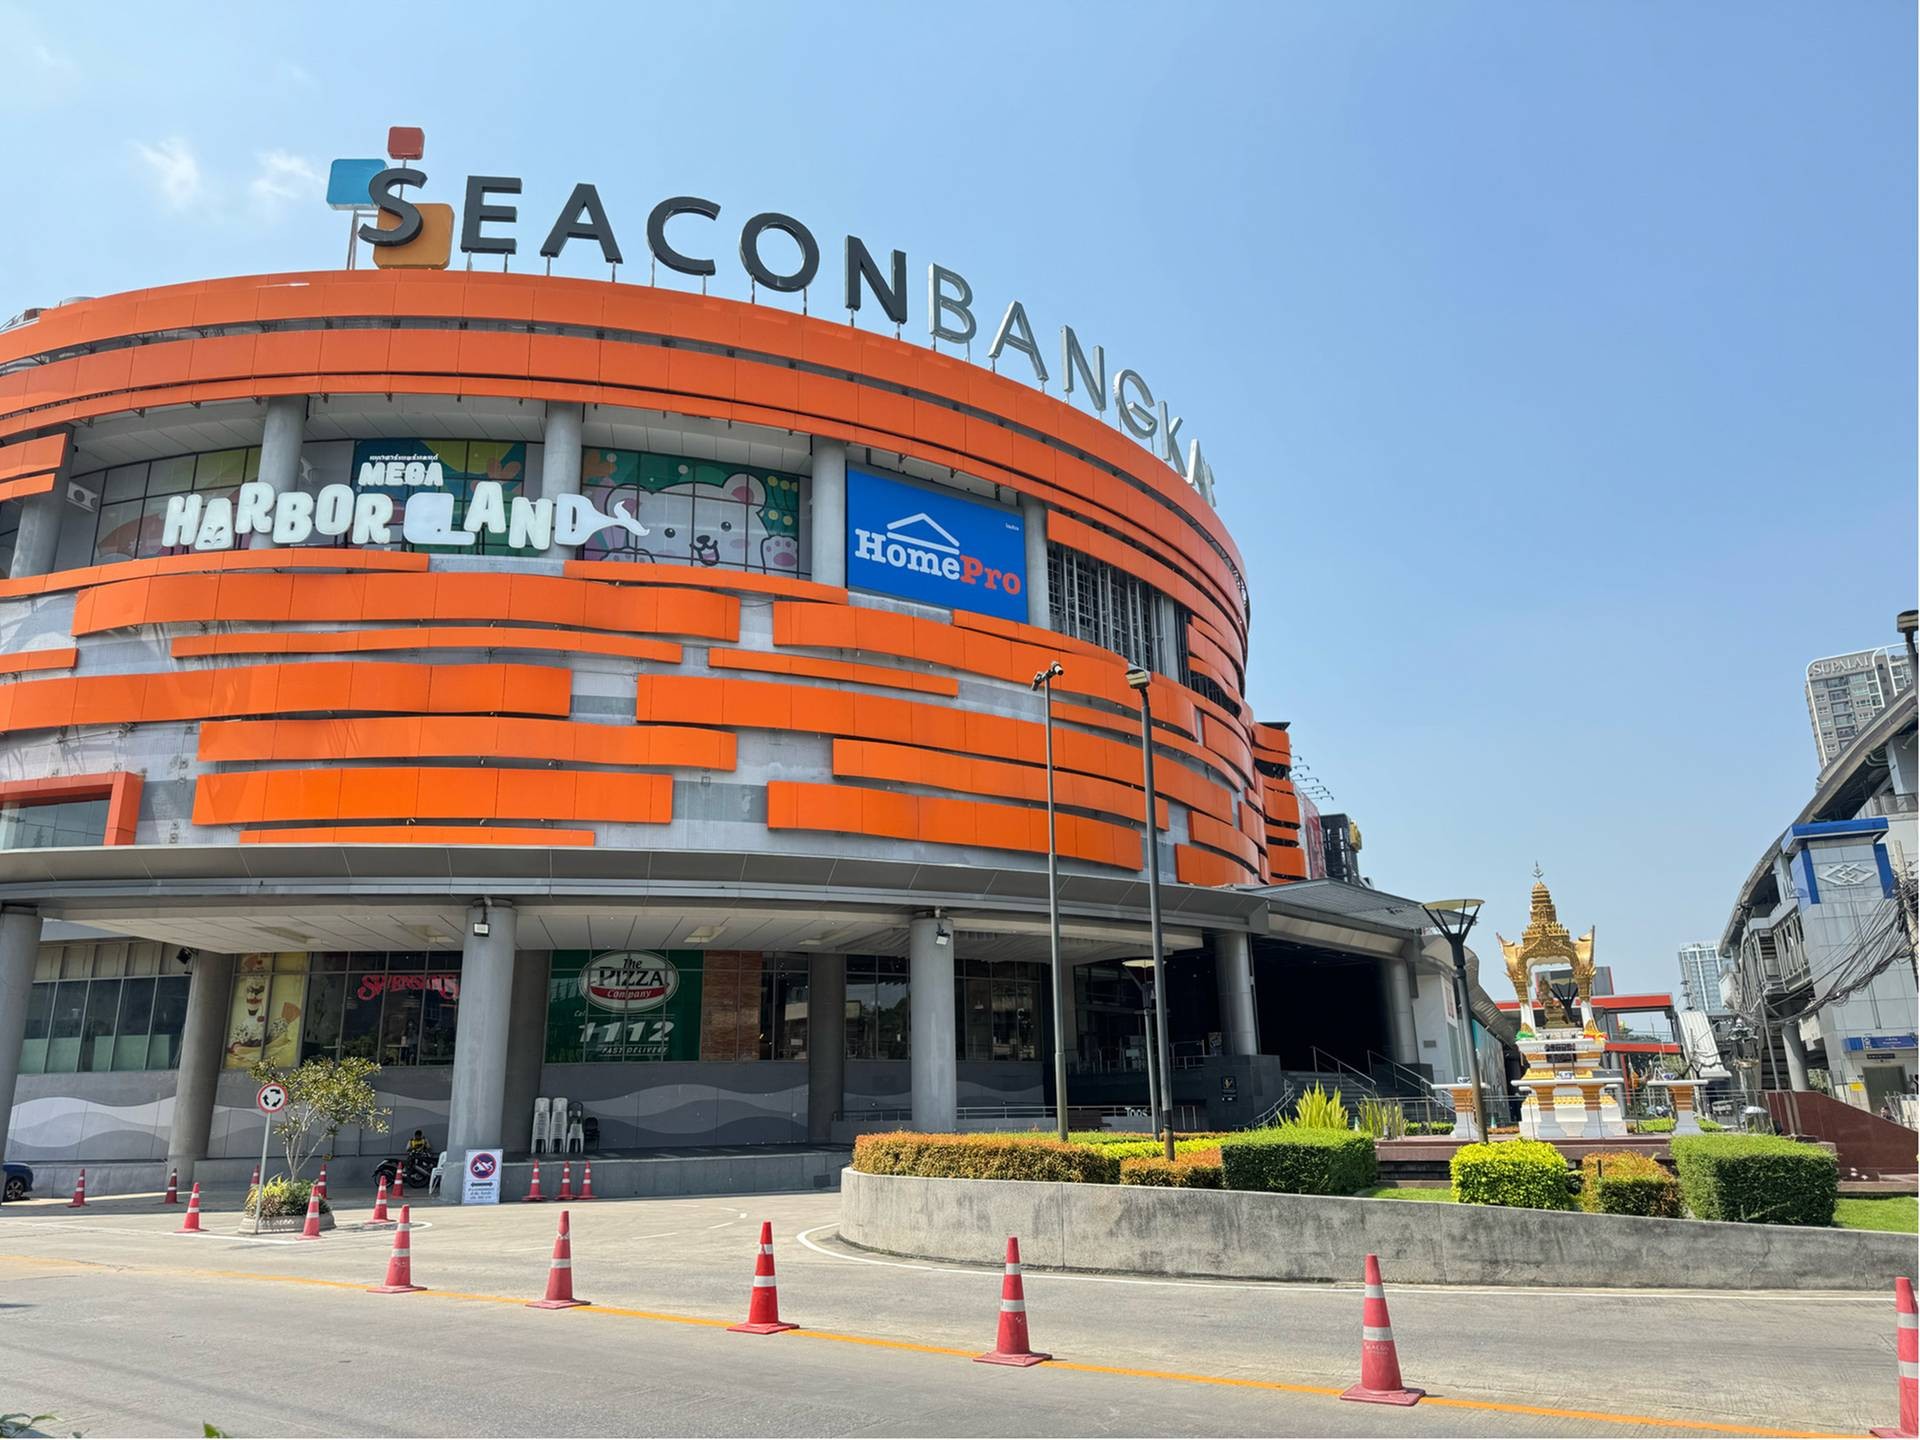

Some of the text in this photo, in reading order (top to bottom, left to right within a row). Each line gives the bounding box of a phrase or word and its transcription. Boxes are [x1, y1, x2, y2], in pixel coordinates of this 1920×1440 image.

[358, 461, 443, 486] MEGA
[161, 481, 649, 551] HARBOR LAND
[855, 528, 1021, 595] HomePro
[1812, 655, 1870, 676] SUPALAI
[623, 958, 642, 969] The
[599, 966, 665, 986] PIZZA
[607, 990, 652, 999] Company
[578, 1021, 675, 1042] 1112
